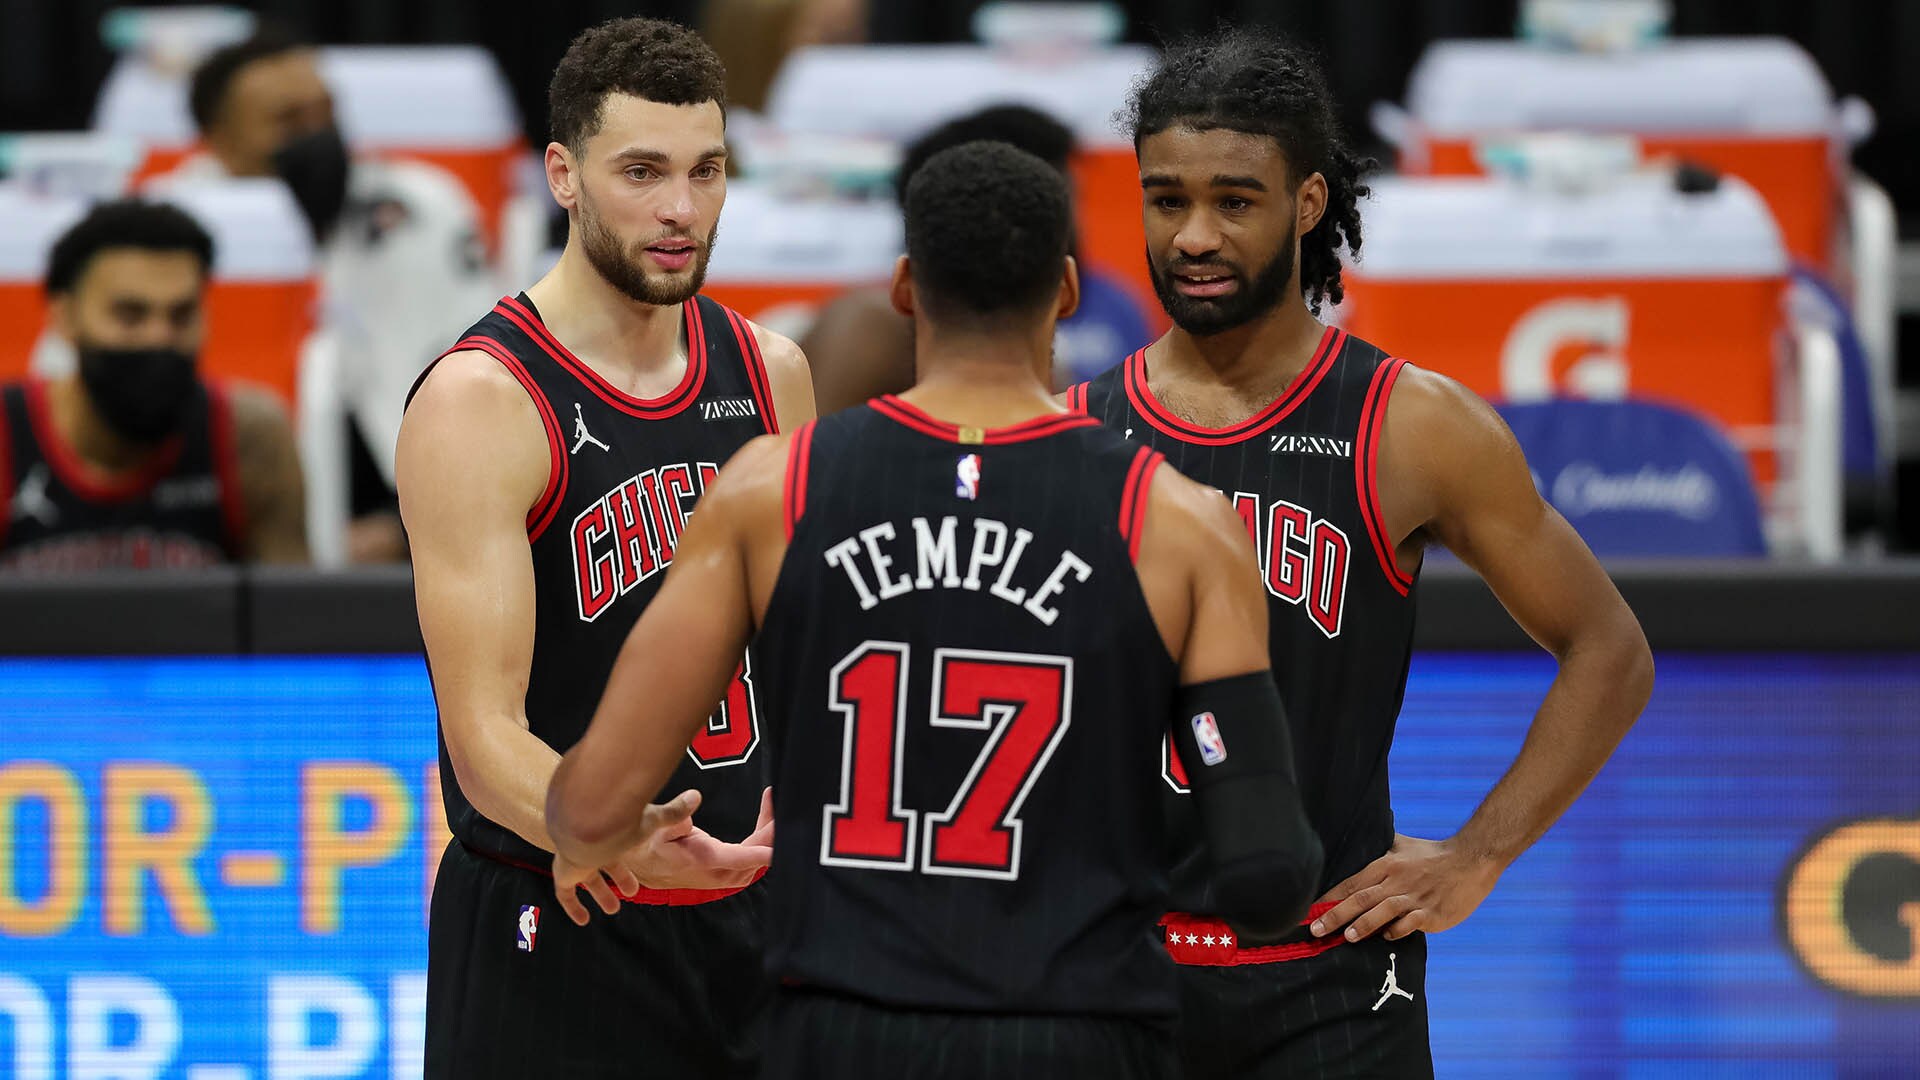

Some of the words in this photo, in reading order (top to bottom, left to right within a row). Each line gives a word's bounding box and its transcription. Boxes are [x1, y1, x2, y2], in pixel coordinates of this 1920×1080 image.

[1271, 435, 1350, 457] ZENNI
[570, 462, 719, 622] CHIC
[824, 516, 1092, 625] TEMPLE
[820, 640, 1073, 881] 17
